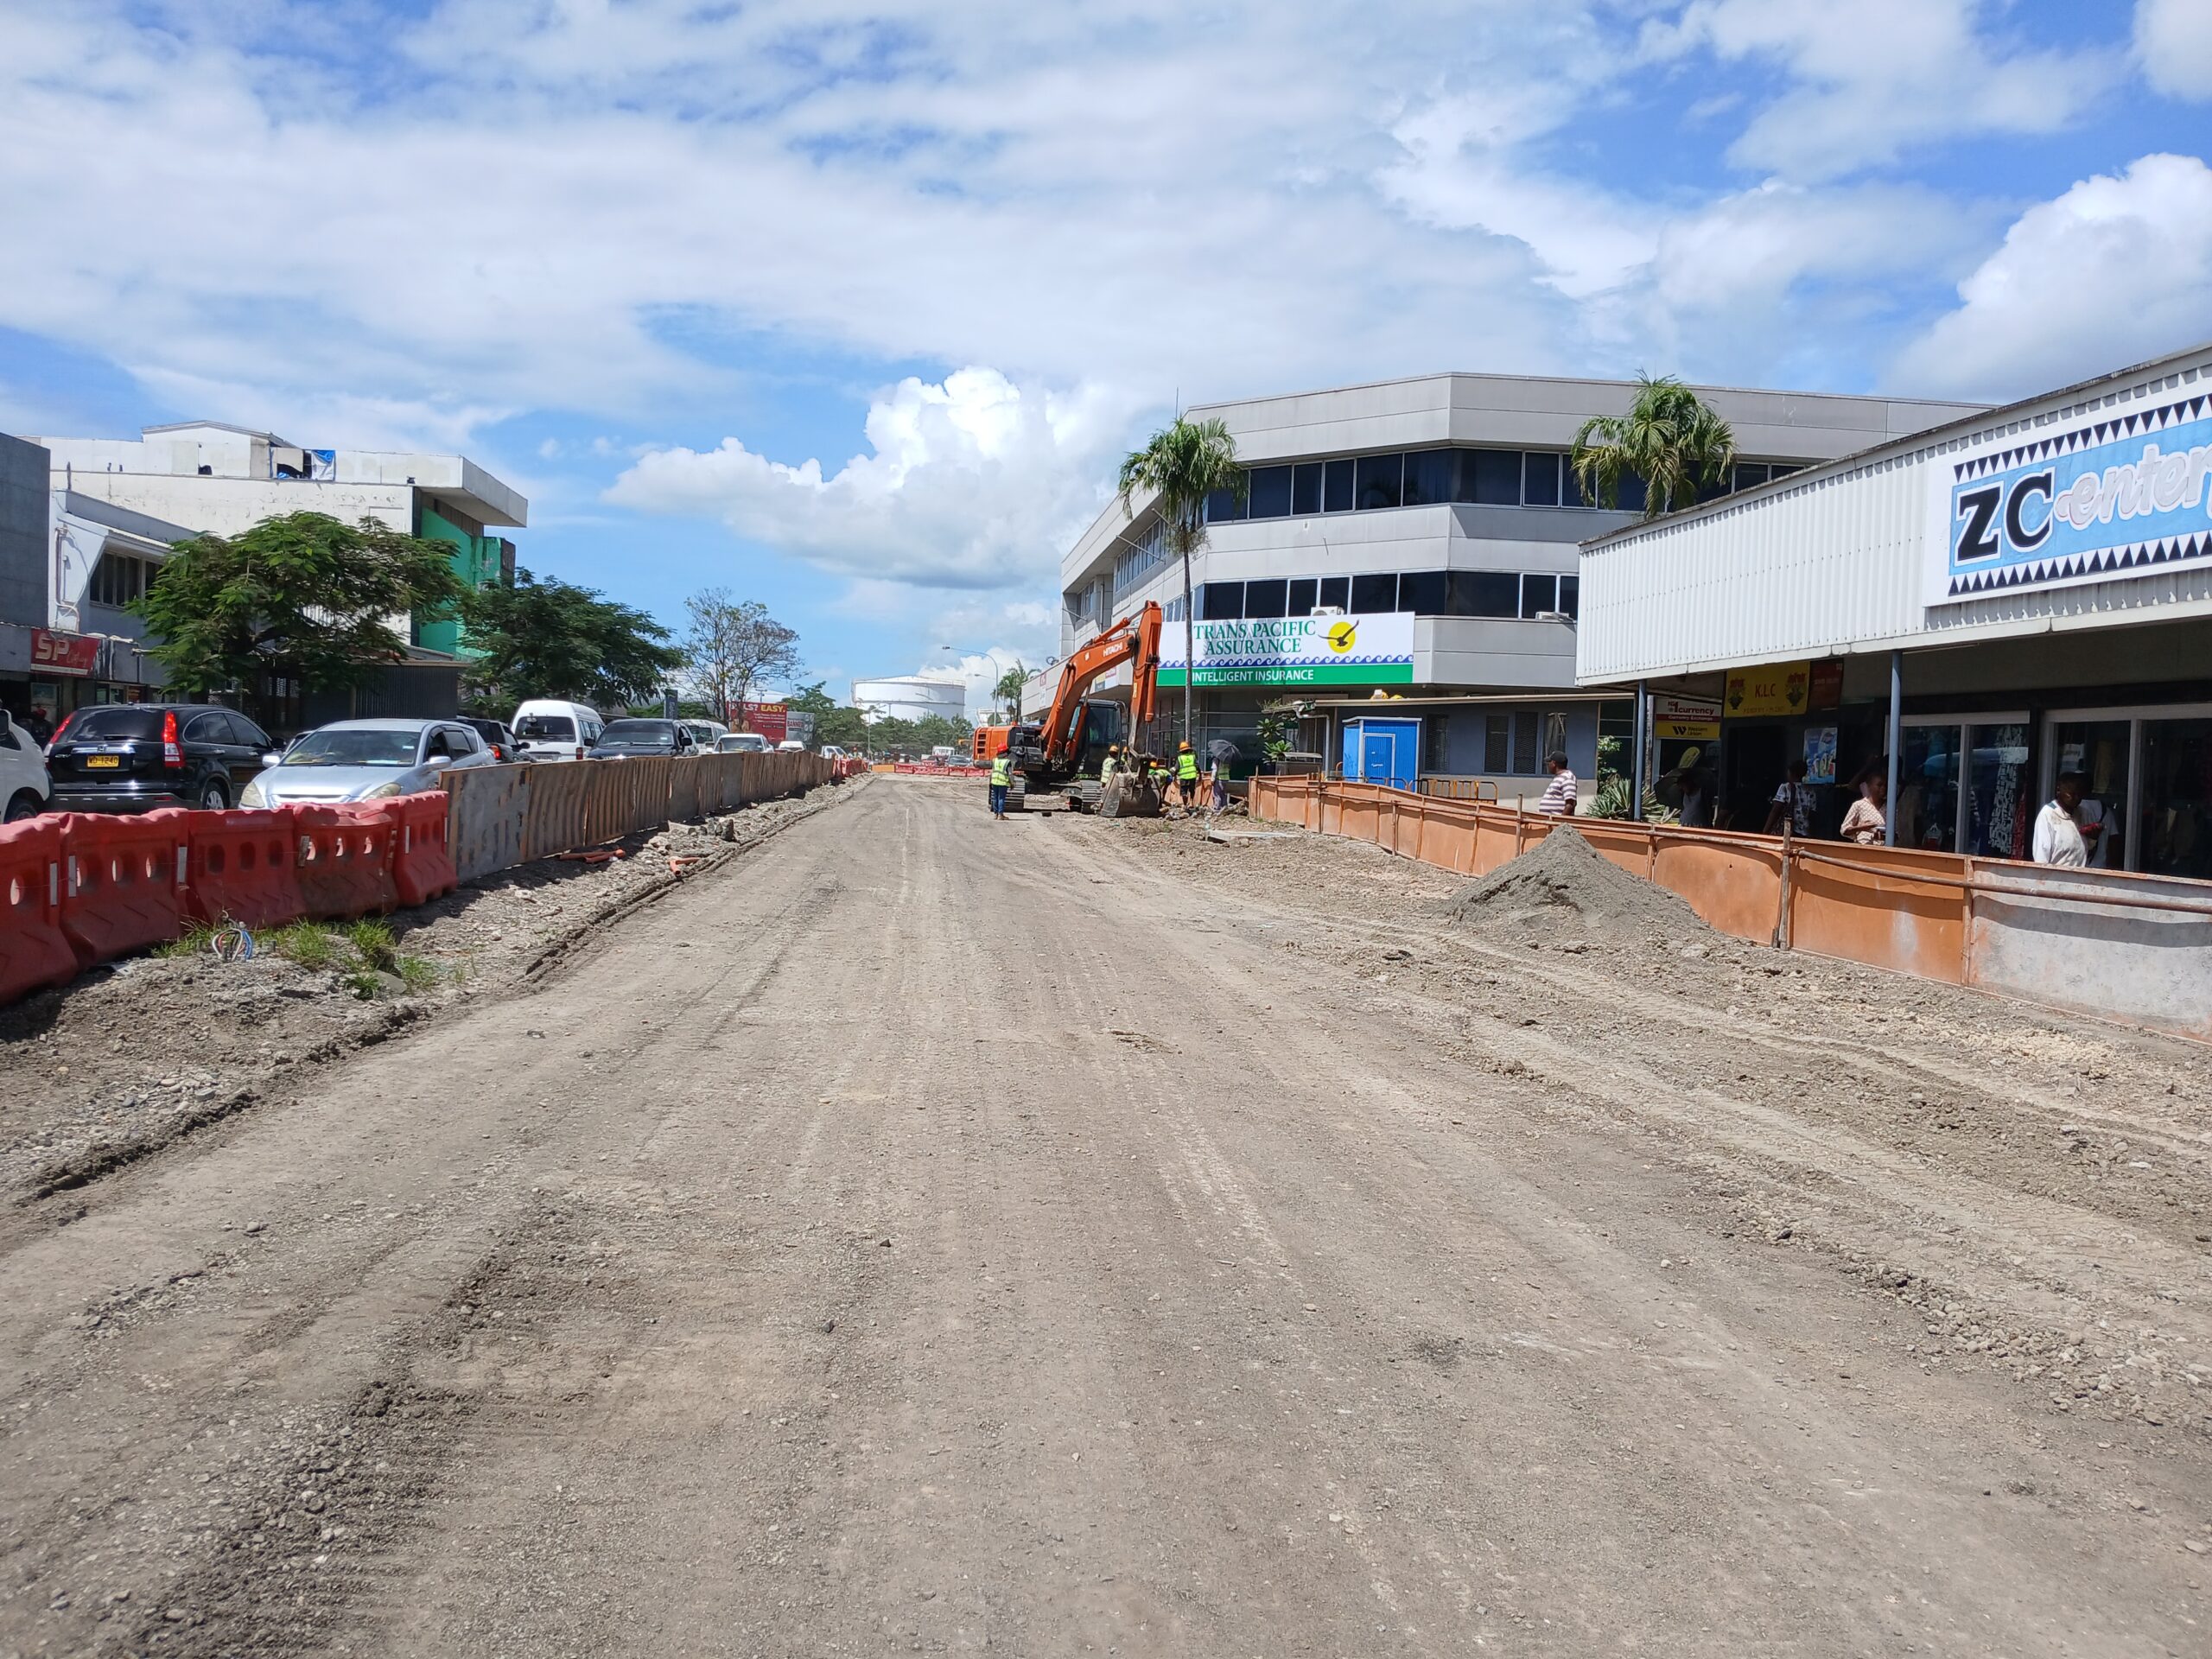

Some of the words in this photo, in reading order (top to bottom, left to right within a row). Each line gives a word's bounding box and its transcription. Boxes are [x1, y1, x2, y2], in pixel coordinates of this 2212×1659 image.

[1956, 471, 2053, 563] ZC
[2056, 446, 2212, 526] enter
[1193, 623, 1247, 639] TRANS
[1252, 620, 1316, 639] PACIFIC
[35, 632, 70, 661] SP
[1103, 641, 1123, 658] HITACHI
[1205, 638, 1301, 656] ASSURANCE
[1192, 671, 1254, 683] INTELLIGENT
[1255, 669, 1314, 681] INSURANCE
[760, 704, 786, 713] EASY.
